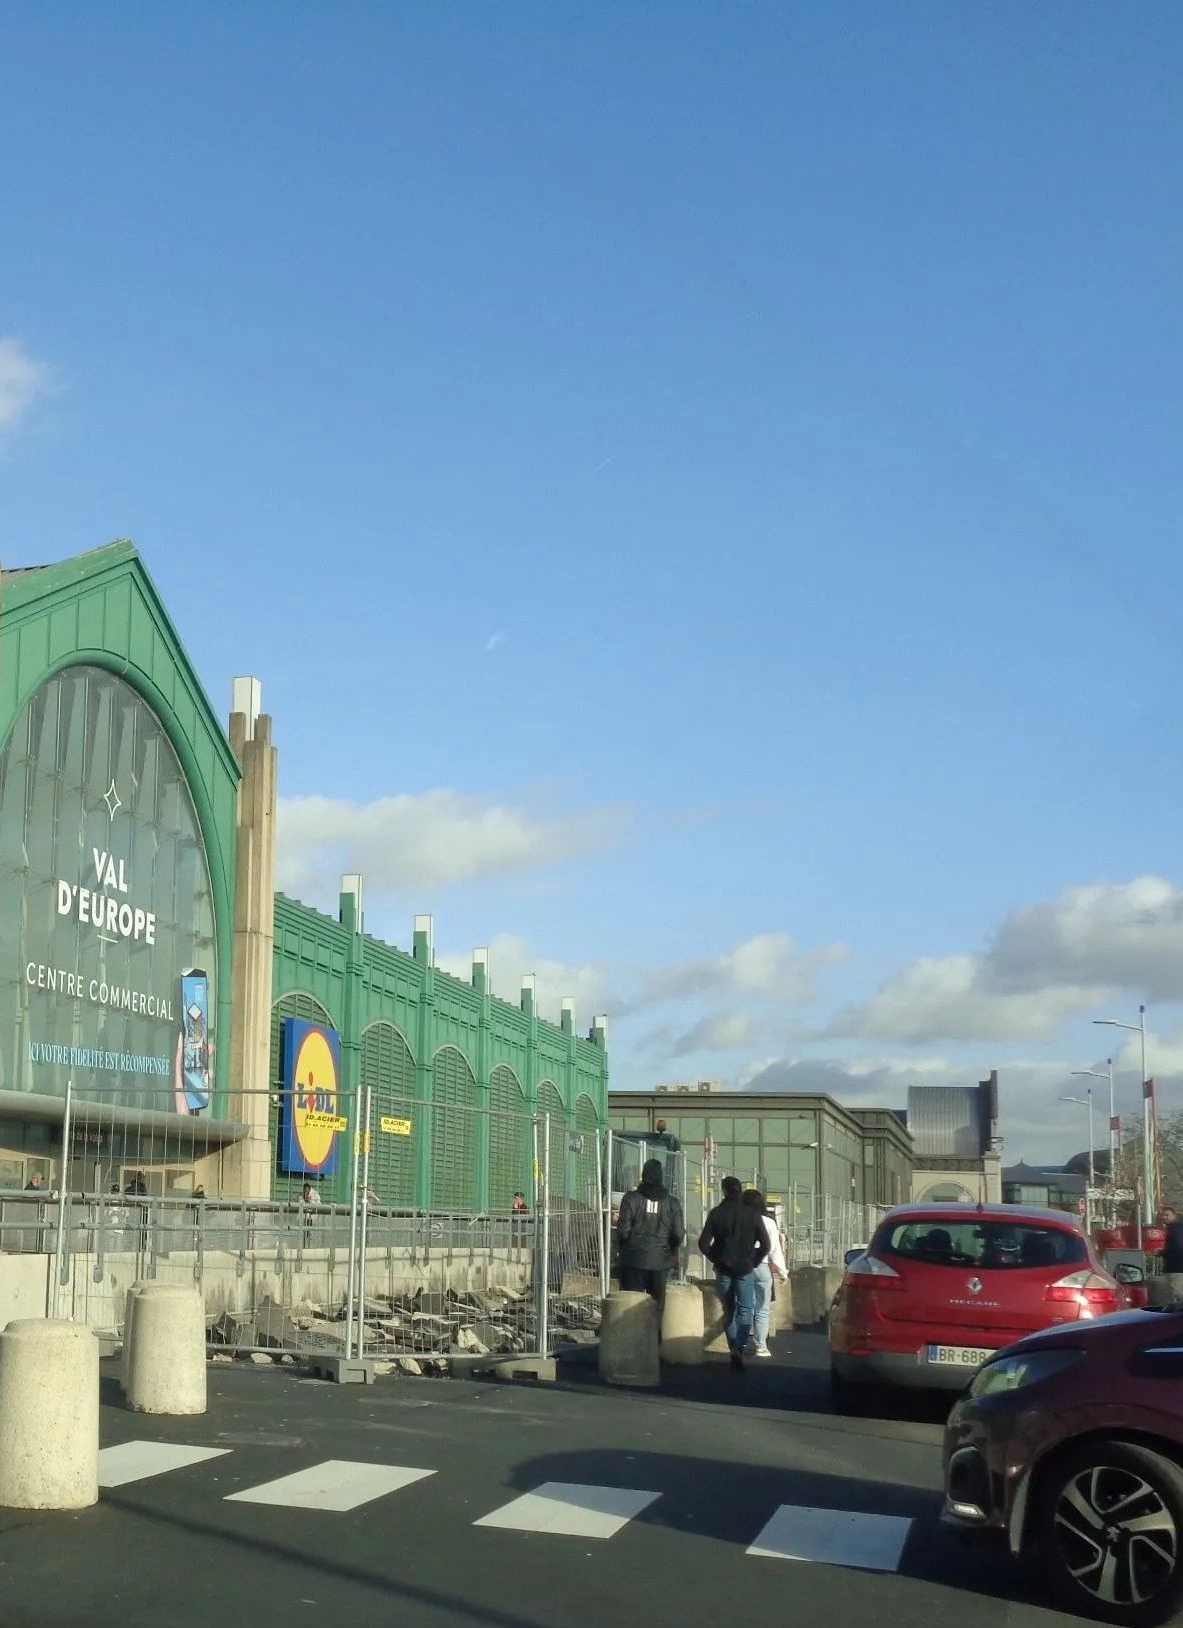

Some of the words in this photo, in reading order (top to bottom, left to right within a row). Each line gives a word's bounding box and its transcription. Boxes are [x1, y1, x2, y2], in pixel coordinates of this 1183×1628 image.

[93, 848, 128, 893] VAL
[58, 880, 156, 945] D'EUROPE
[26, 962, 84, 998] CENTRE
[89, 980, 174, 1021] COMMERCIAL
[28, 1042, 39, 1062] ICI
[41, 1044, 69, 1065] VOTRE
[105, 1051, 120, 1070] EST
